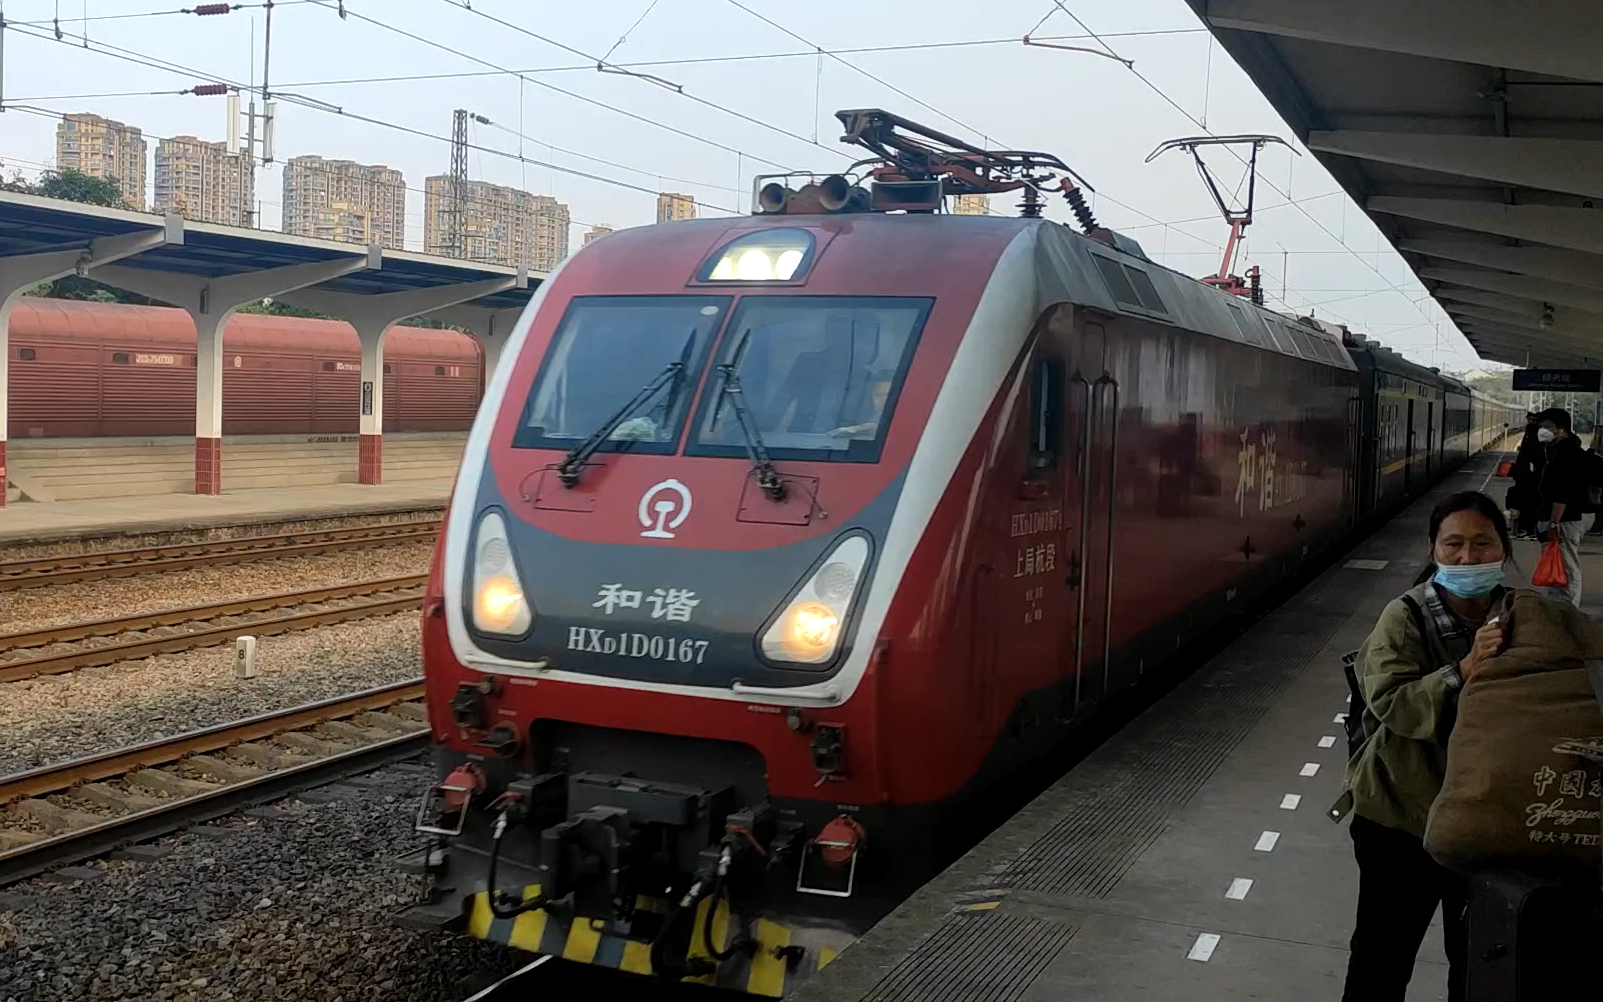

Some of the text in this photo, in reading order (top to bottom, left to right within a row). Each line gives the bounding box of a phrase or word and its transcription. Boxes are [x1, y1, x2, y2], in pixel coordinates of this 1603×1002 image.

[1235, 424, 1277, 518] 和谐
[591, 583, 701, 622] 和谐
[238, 649, 245, 660] 8
[567, 626, 710, 664] HXD1D0167
